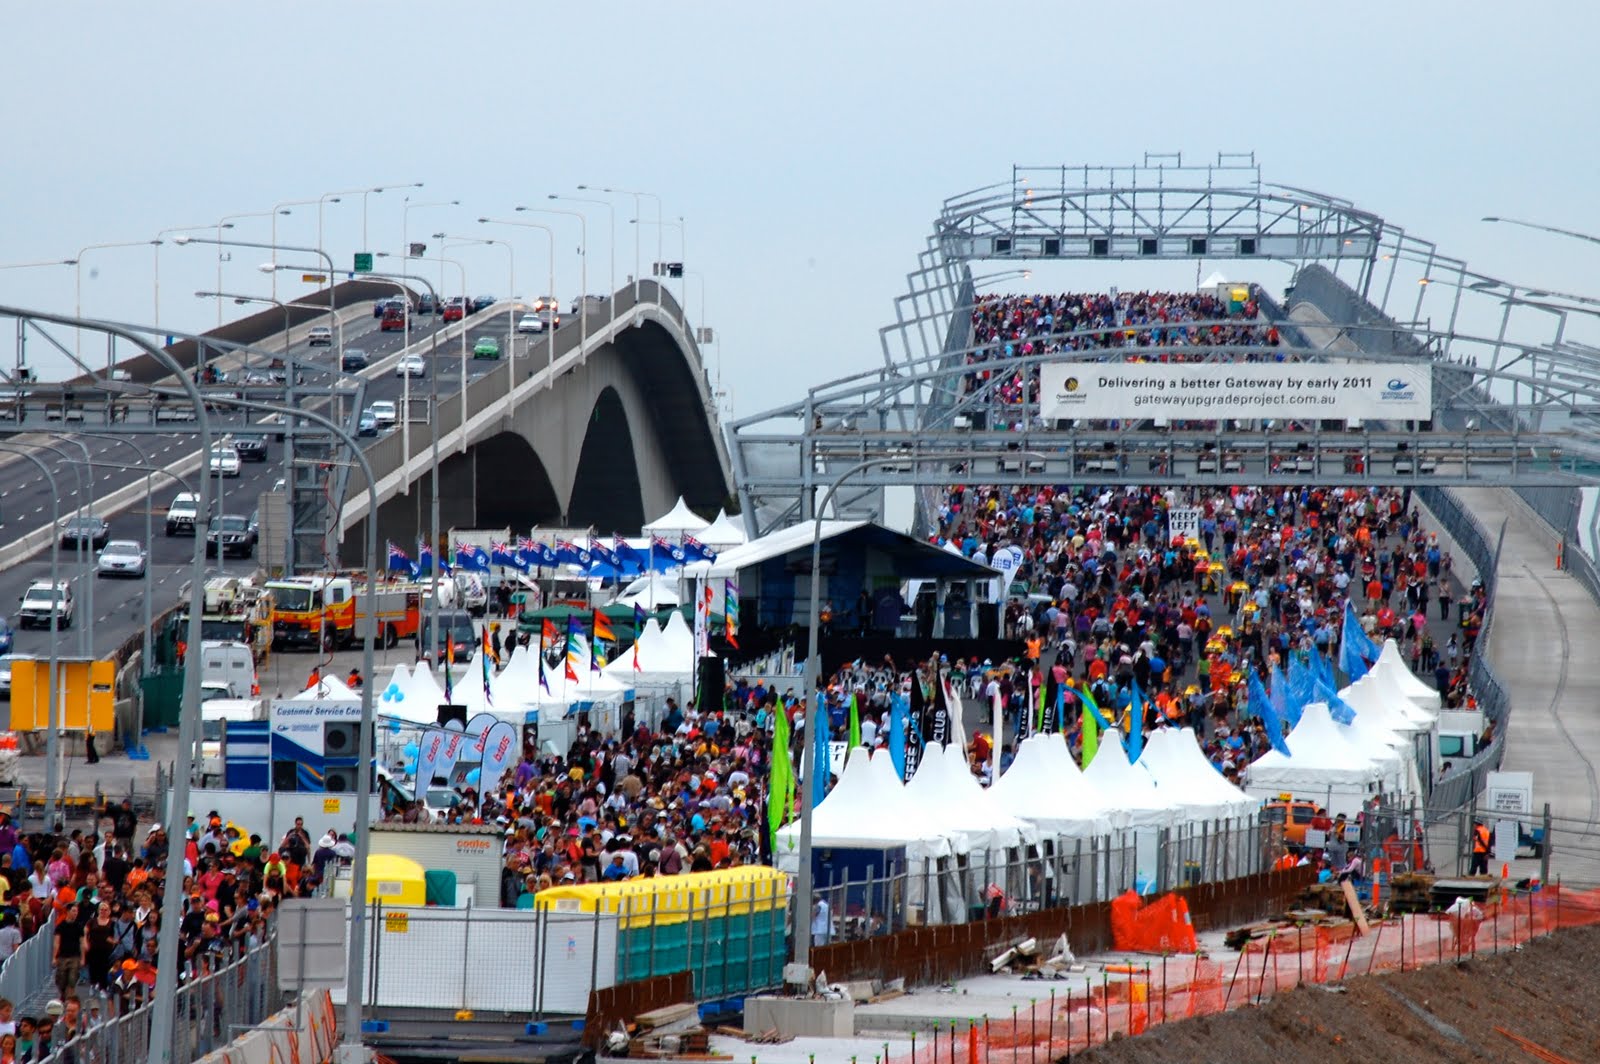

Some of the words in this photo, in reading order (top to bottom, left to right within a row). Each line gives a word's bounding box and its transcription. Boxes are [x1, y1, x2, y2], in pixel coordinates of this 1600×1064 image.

[1098, 376, 1166, 391] Delivering
[1169, 379, 1178, 389] a
[1181, 376, 1222, 389] better
[1225, 376, 1284, 391] Gateway
[1287, 376, 1304, 391] by
[1307, 376, 1340, 391] early
[1343, 376, 1372, 388] 2011
[1134, 393, 1336, 408] gatewayupgradeproject.com.au
[1170, 512, 1197, 521] KEEP
[1171, 521, 1195, 530] LEFT
[277, 706, 313, 716] Customer
[315, 706, 344, 716] Service
[346, 706, 362, 716] Cen
[933, 709, 946, 742] CLUB
